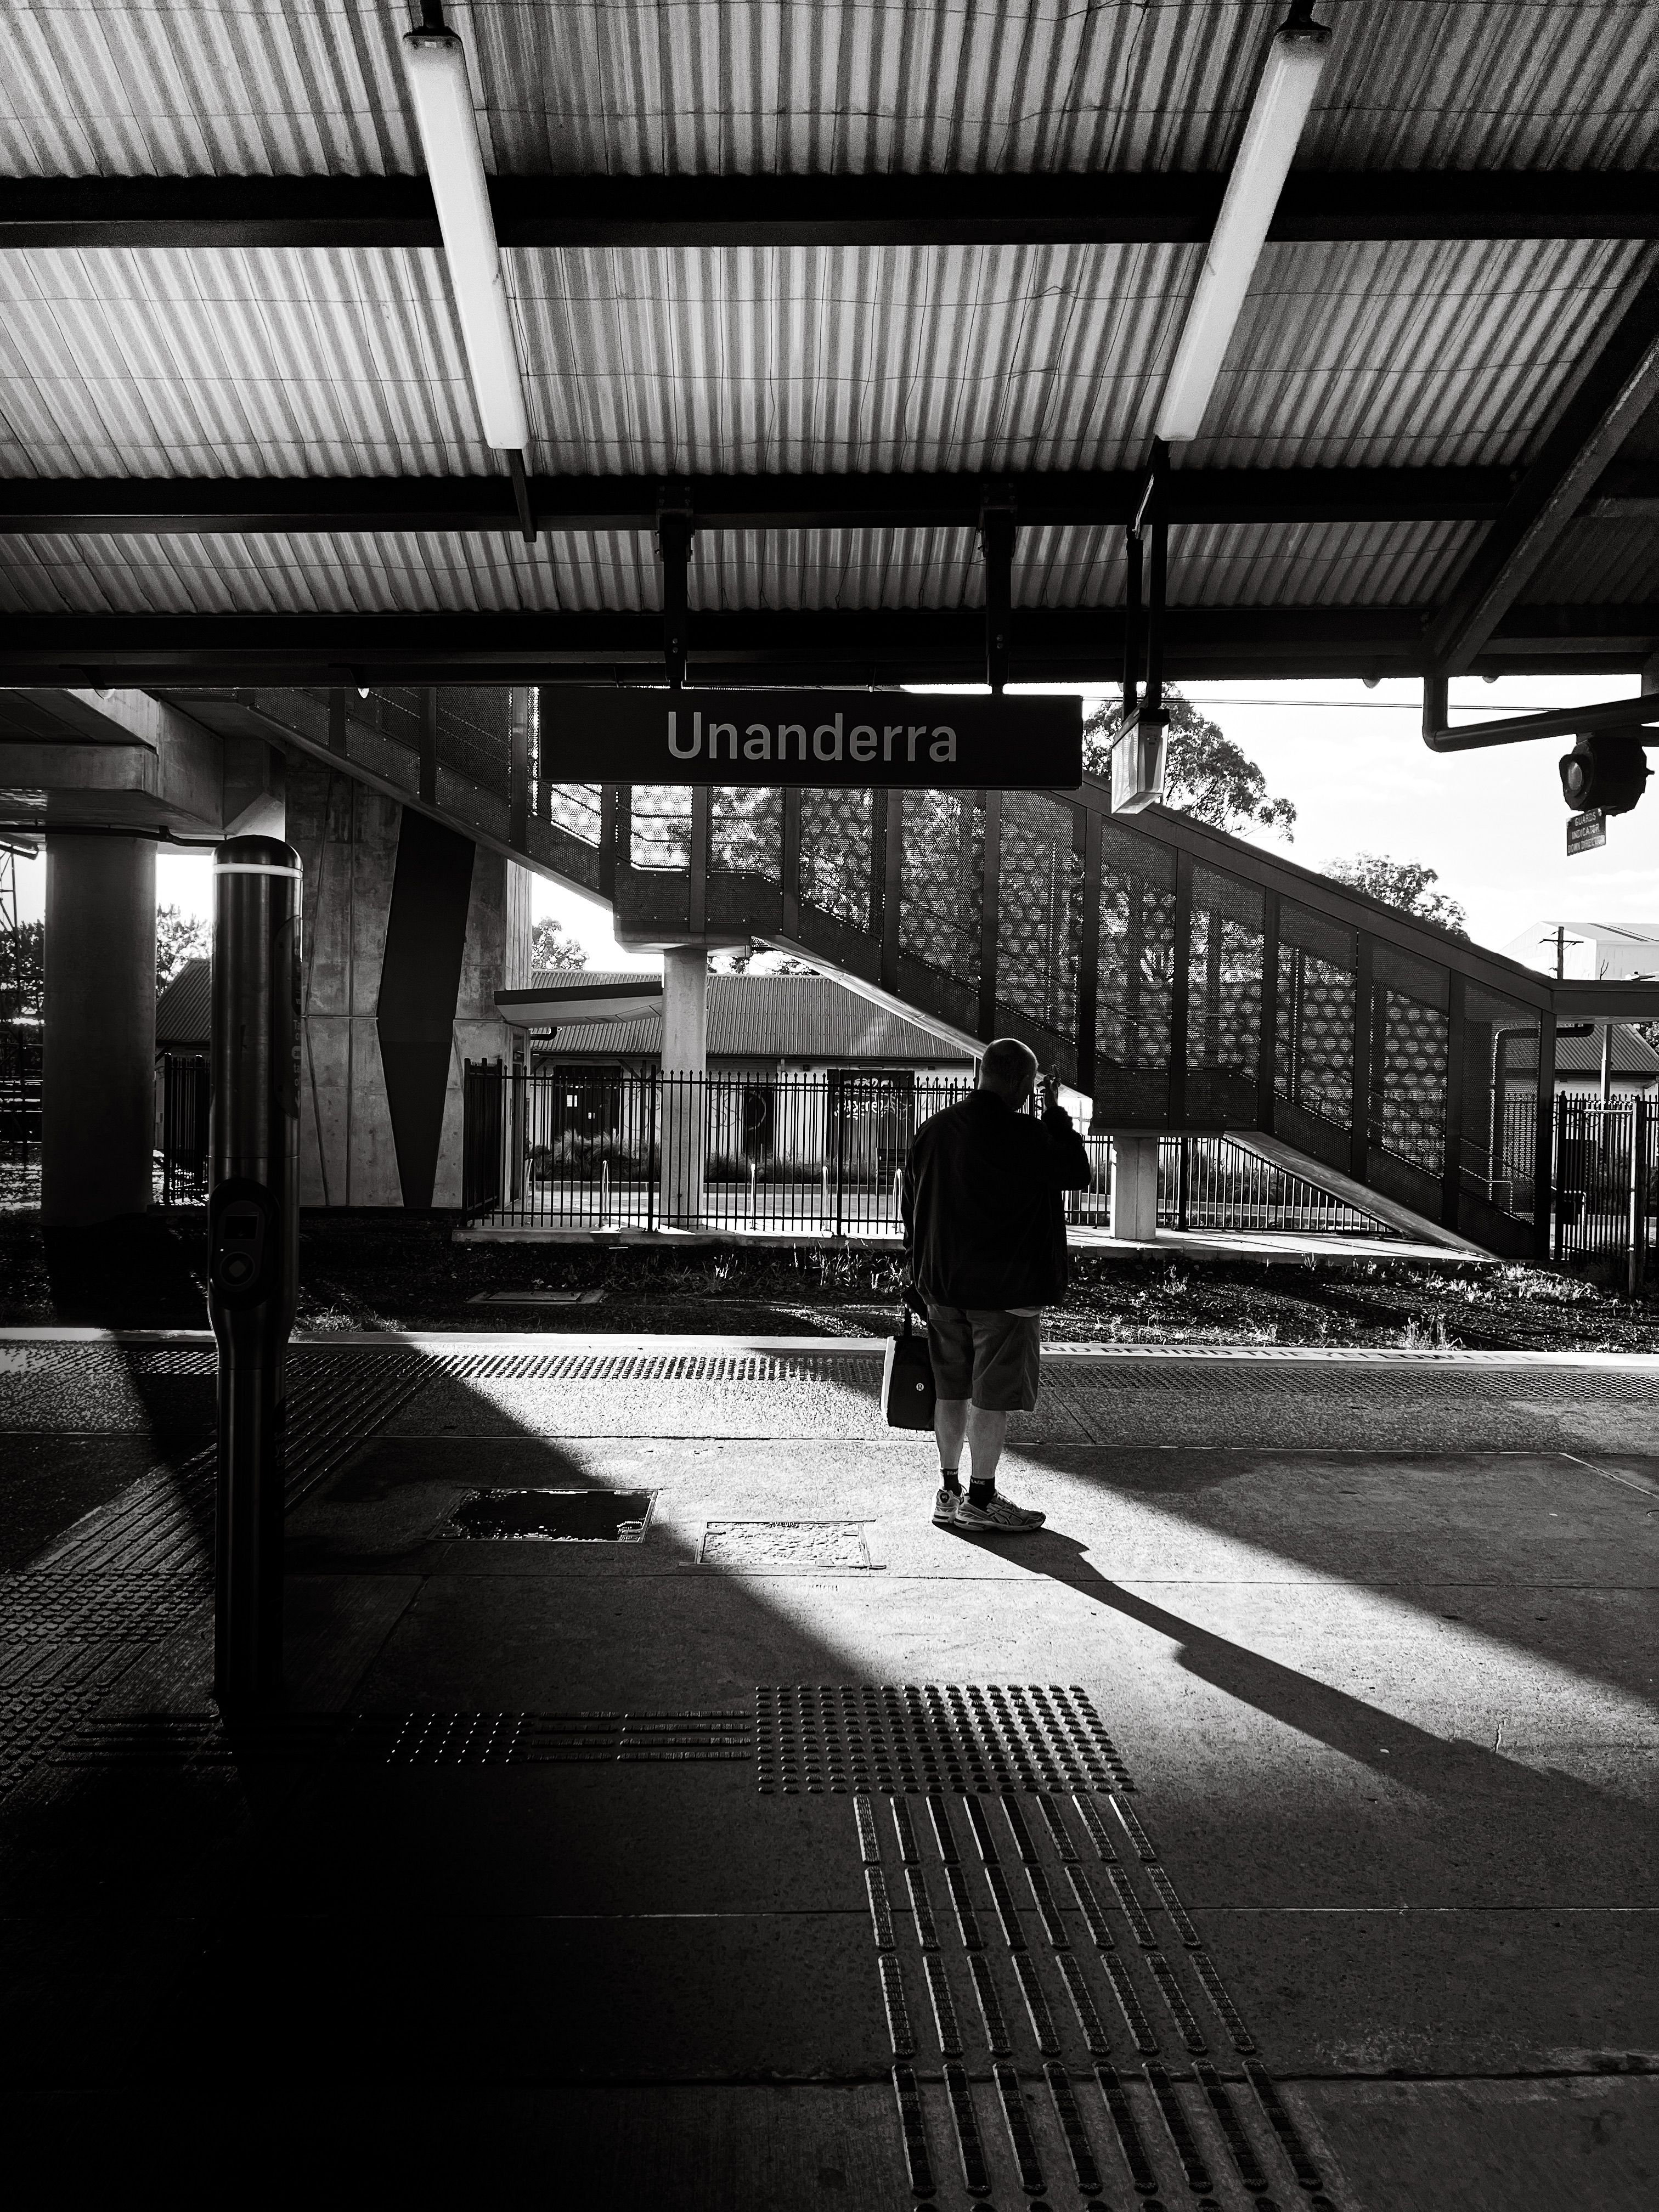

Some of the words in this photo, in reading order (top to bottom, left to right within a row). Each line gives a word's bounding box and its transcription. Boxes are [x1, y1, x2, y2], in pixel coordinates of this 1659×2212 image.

[668, 712, 956, 761] Unanderra
[1575, 811, 1596, 826] GUARDS
[1572, 823, 1600, 840] INDICATOR
[1313, 1352, 1455, 1361] YELLOW
